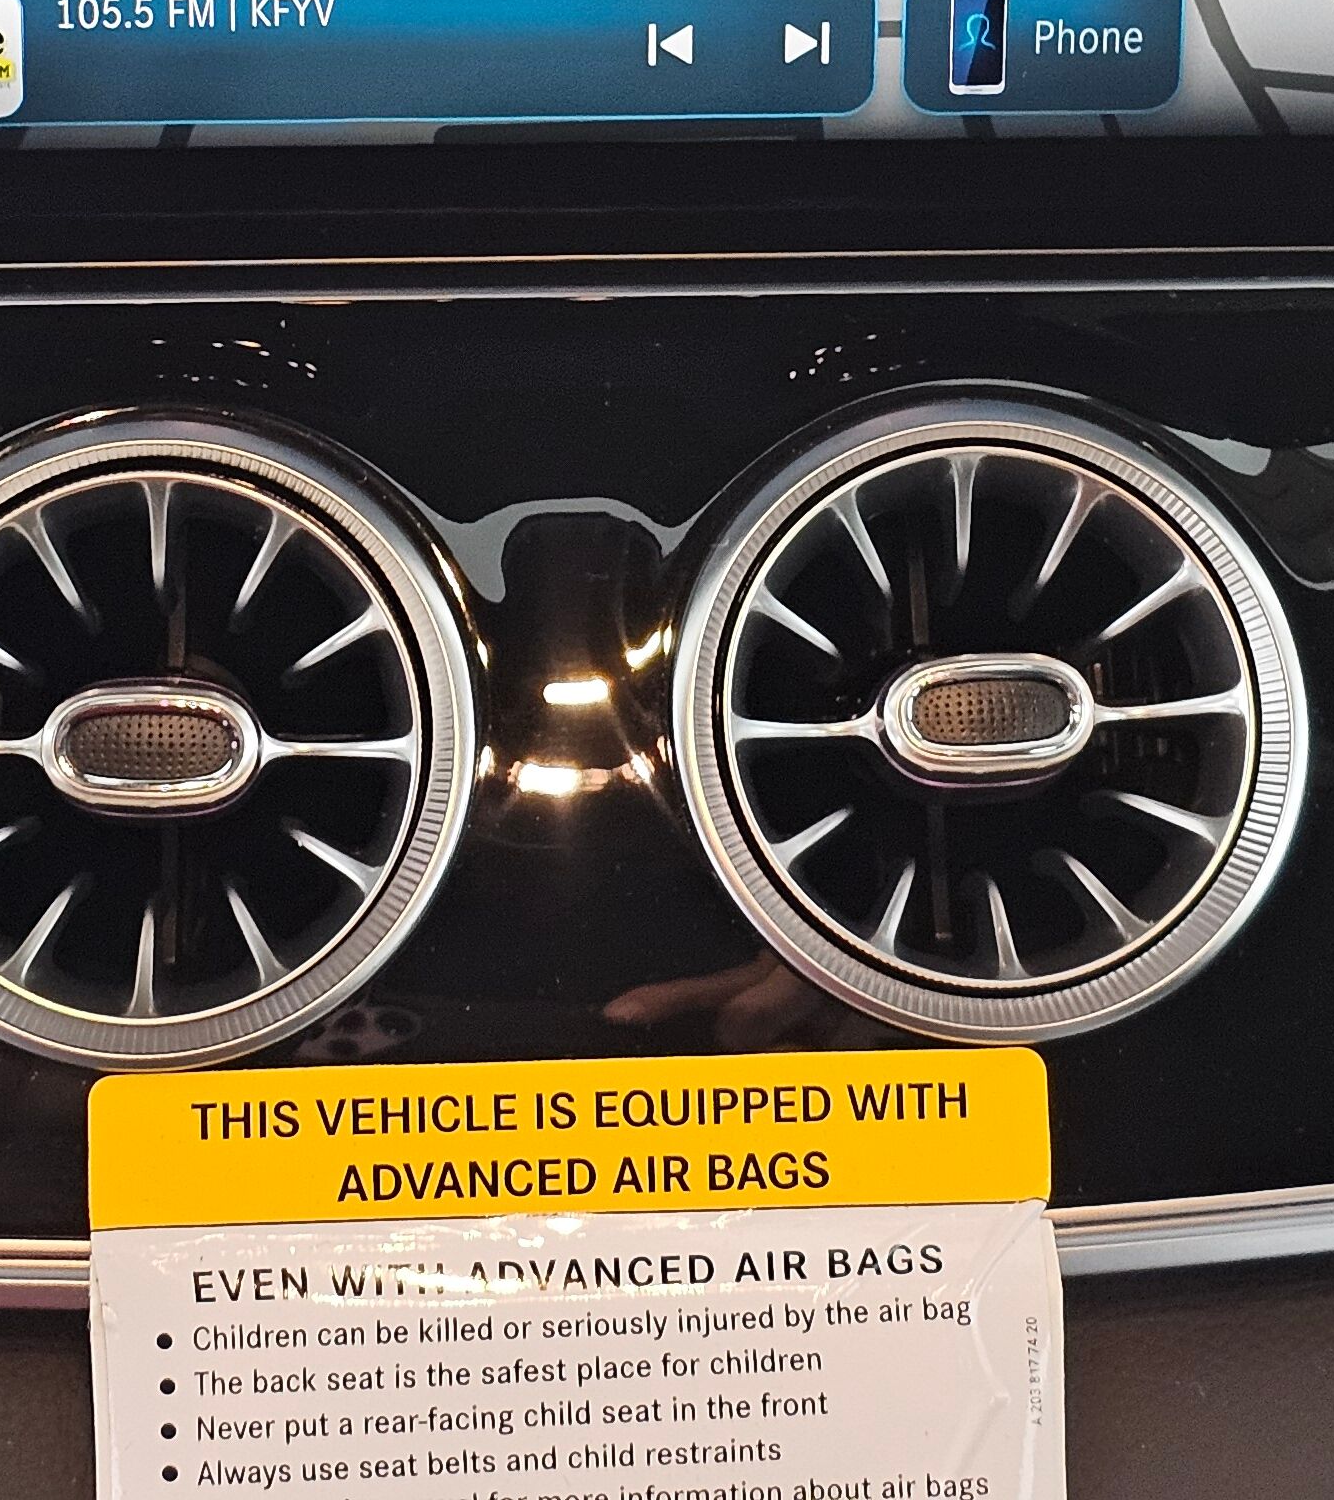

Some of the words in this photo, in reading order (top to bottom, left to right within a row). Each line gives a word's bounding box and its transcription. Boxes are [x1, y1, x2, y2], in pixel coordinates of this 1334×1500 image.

[1036, 19, 1142, 54] Phone
[191, 1101, 299, 1140] THIS
[316, 1094, 517, 1135] VEHICLE
[536, 1092, 576, 1129] IS
[596, 1086, 830, 1127] EQUIPPED
[849, 1083, 967, 1120] WITH
[338, 1159, 596, 1202] ADVANCED
[613, 1156, 690, 1193] AIR
[709, 1152, 829, 1190] BAGS
[193, 1267, 307, 1302] EVEN
[735, 1251, 806, 1282] AIR
[829, 1245, 942, 1278] BAGS
[194, 1324, 306, 1351] Children
[318, 1327, 364, 1346] can
[377, 1320, 408, 1344] be
[420, 1316, 492, 1342] killed
[504, 1321, 531, 1339] or
[543, 1310, 667, 1340] seriously
[678, 1305, 773, 1338] injured
[785, 1304, 814, 1333] by
[826, 1301, 868, 1325] the
[880, 1298, 912, 1322] air
[923, 1297, 971, 1326] bag
[1025, 1317, 1038, 1333] 20
[195, 1371, 242, 1395] The
[254, 1367, 315, 1393] back
[328, 1367, 384, 1391] seat
[396, 1364, 415, 1388] is
[427, 1362, 470, 1387] the
[482, 1359, 566, 1384] safest
[578, 1356, 651, 1387] place
[662, 1353, 699, 1377] for
[711, 1349, 821, 1374] children
[198, 1416, 275, 1441] Never
[286, 1414, 328, 1444] put
[340, 1418, 352, 1435] a
[365, 1405, 513, 1435] rear-facing
[525, 1400, 590, 1426] child
[603, 1400, 661, 1423] seat
[673, 1397, 695, 1421] in
[707, 1395, 750, 1419] the
[762, 1393, 827, 1417] front
[198, 1461, 291, 1490] Always
[303, 1462, 348, 1481] use
[360, 1455, 417, 1478] seat
[428, 1450, 495, 1475] belts
[507, 1446, 556, 1471] and
[569, 1443, 634, 1468] child
[647, 1439, 781, 1466] restraints
[794, 1478, 870, 1500] about
[882, 1474, 915, 1499] air
[927, 1474, 988, 1500] bags
